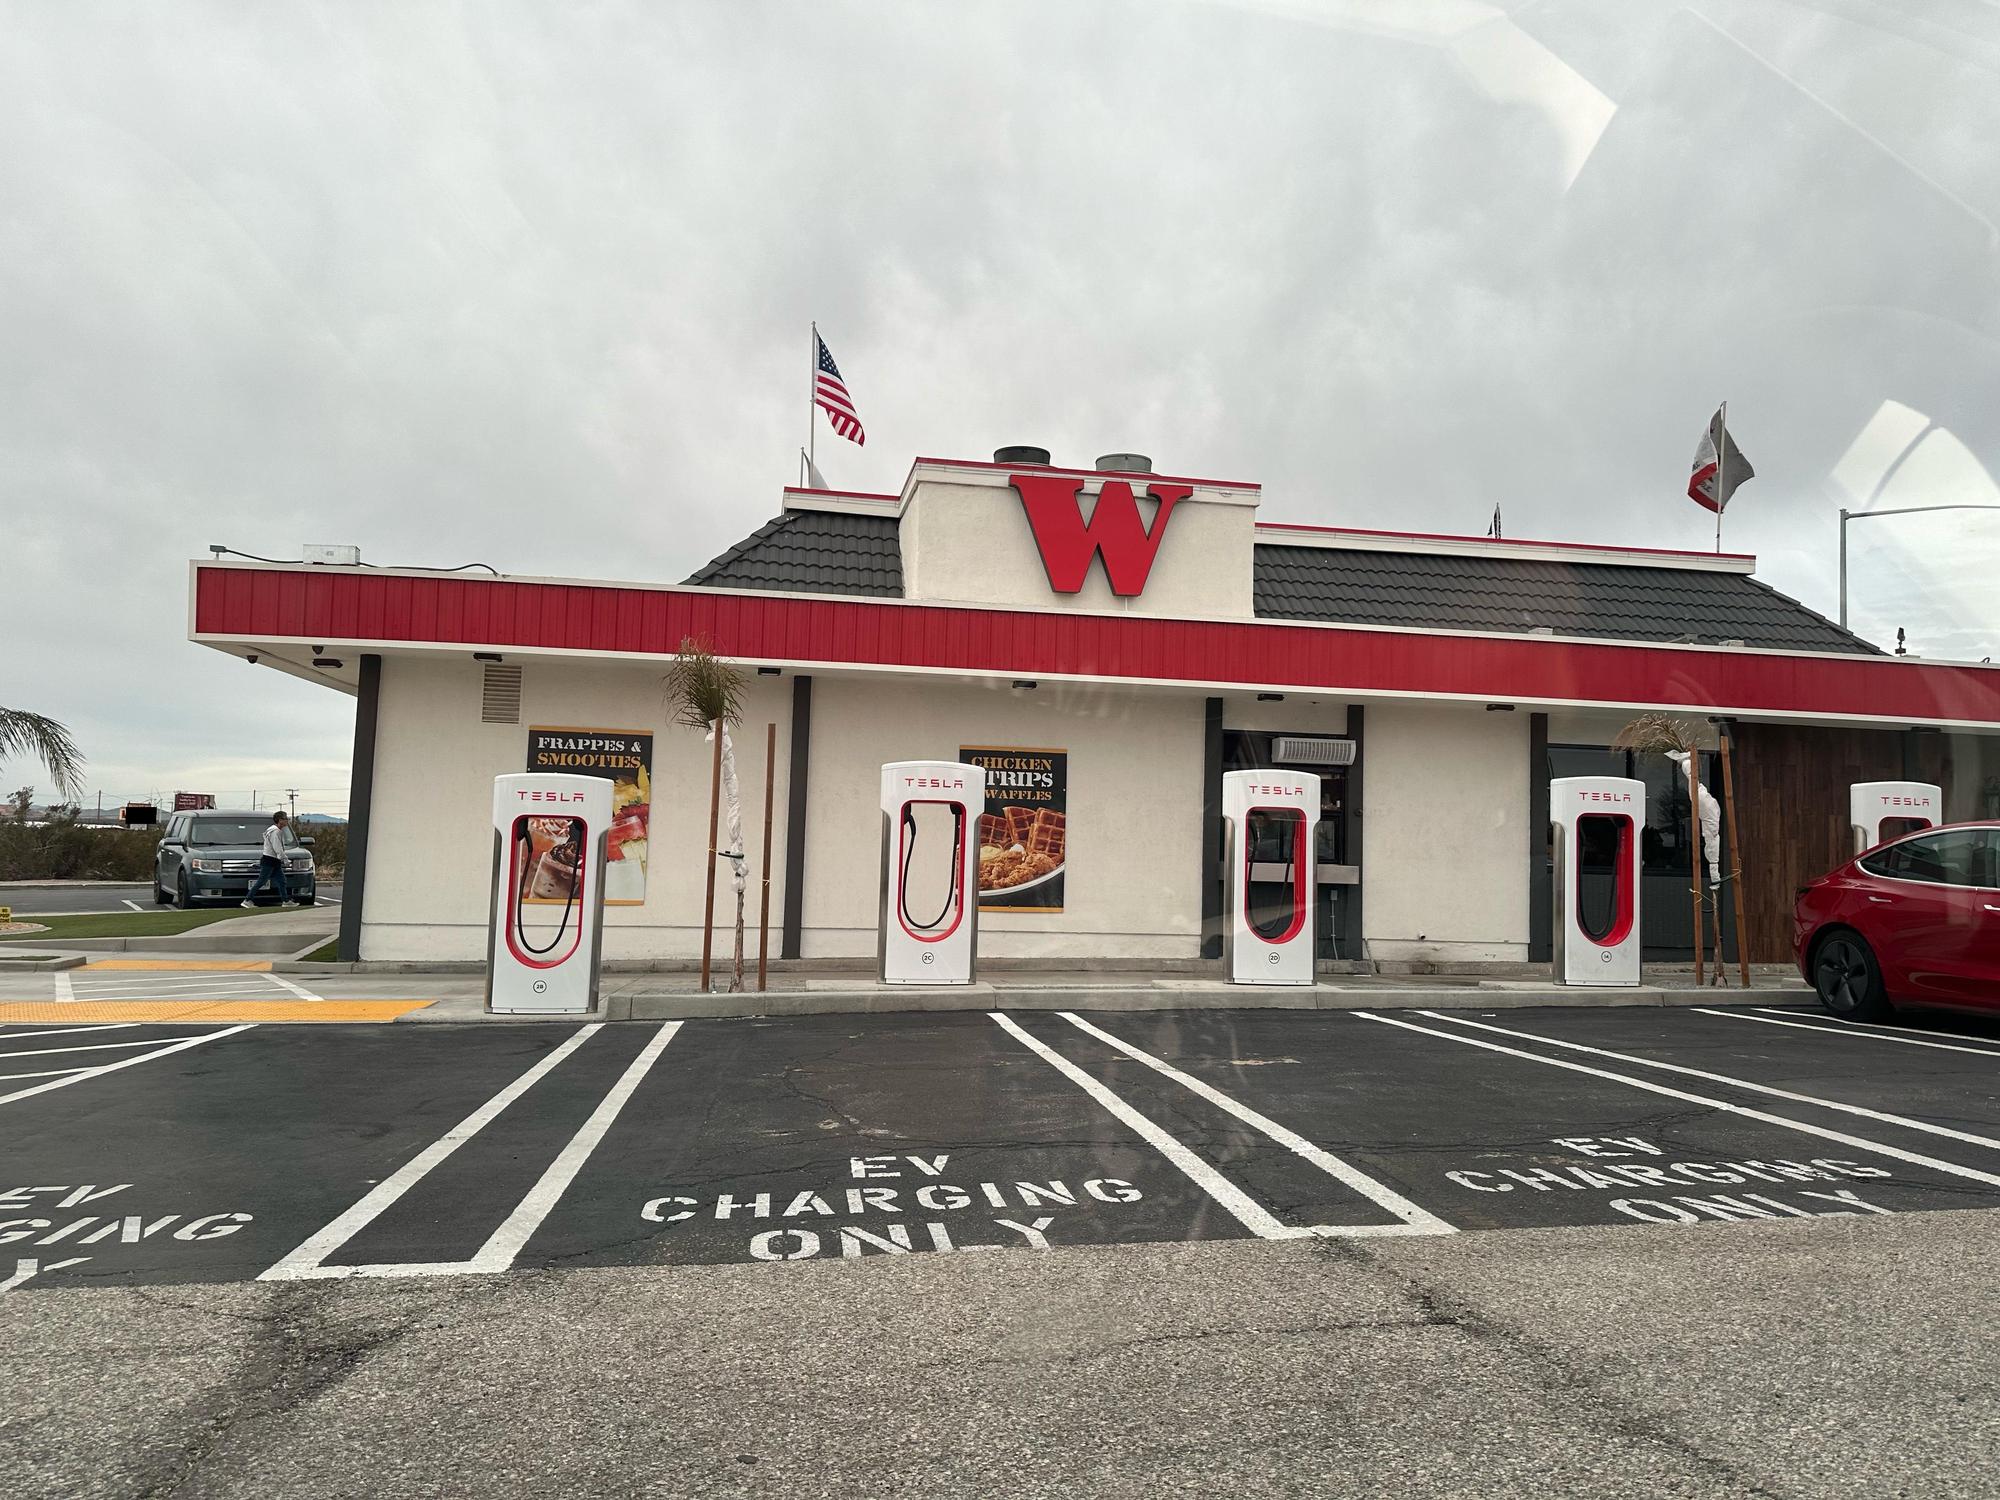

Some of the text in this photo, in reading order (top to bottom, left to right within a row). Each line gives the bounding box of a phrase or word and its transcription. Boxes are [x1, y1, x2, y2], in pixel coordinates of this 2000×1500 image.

[1008, 474, 1194, 598] W
[537, 737, 642, 753] FRAPPES &
[971, 756, 1053, 771] CHICKEN
[905, 778, 963, 789] TESLA
[984, 770, 1054, 788] TRIPS
[517, 791, 584, 802] TESLA
[984, 788, 1052, 801] WAFFLES
[1249, 785, 1303, 796] TESLA
[1579, 792, 1631, 802] TESLA
[1880, 796, 1930, 807] TESLA
[1549, 1136, 1665, 1158] EV
[850, 1155, 950, 1178] EV
[1444, 1157, 1893, 1193] CHARGING
[0, 1184, 134, 1210] EV
[640, 1178, 1144, 1223] CHARGING
[1609, 1190, 1897, 1224] ONLY
[749, 1216, 1055, 1261] ONLY
